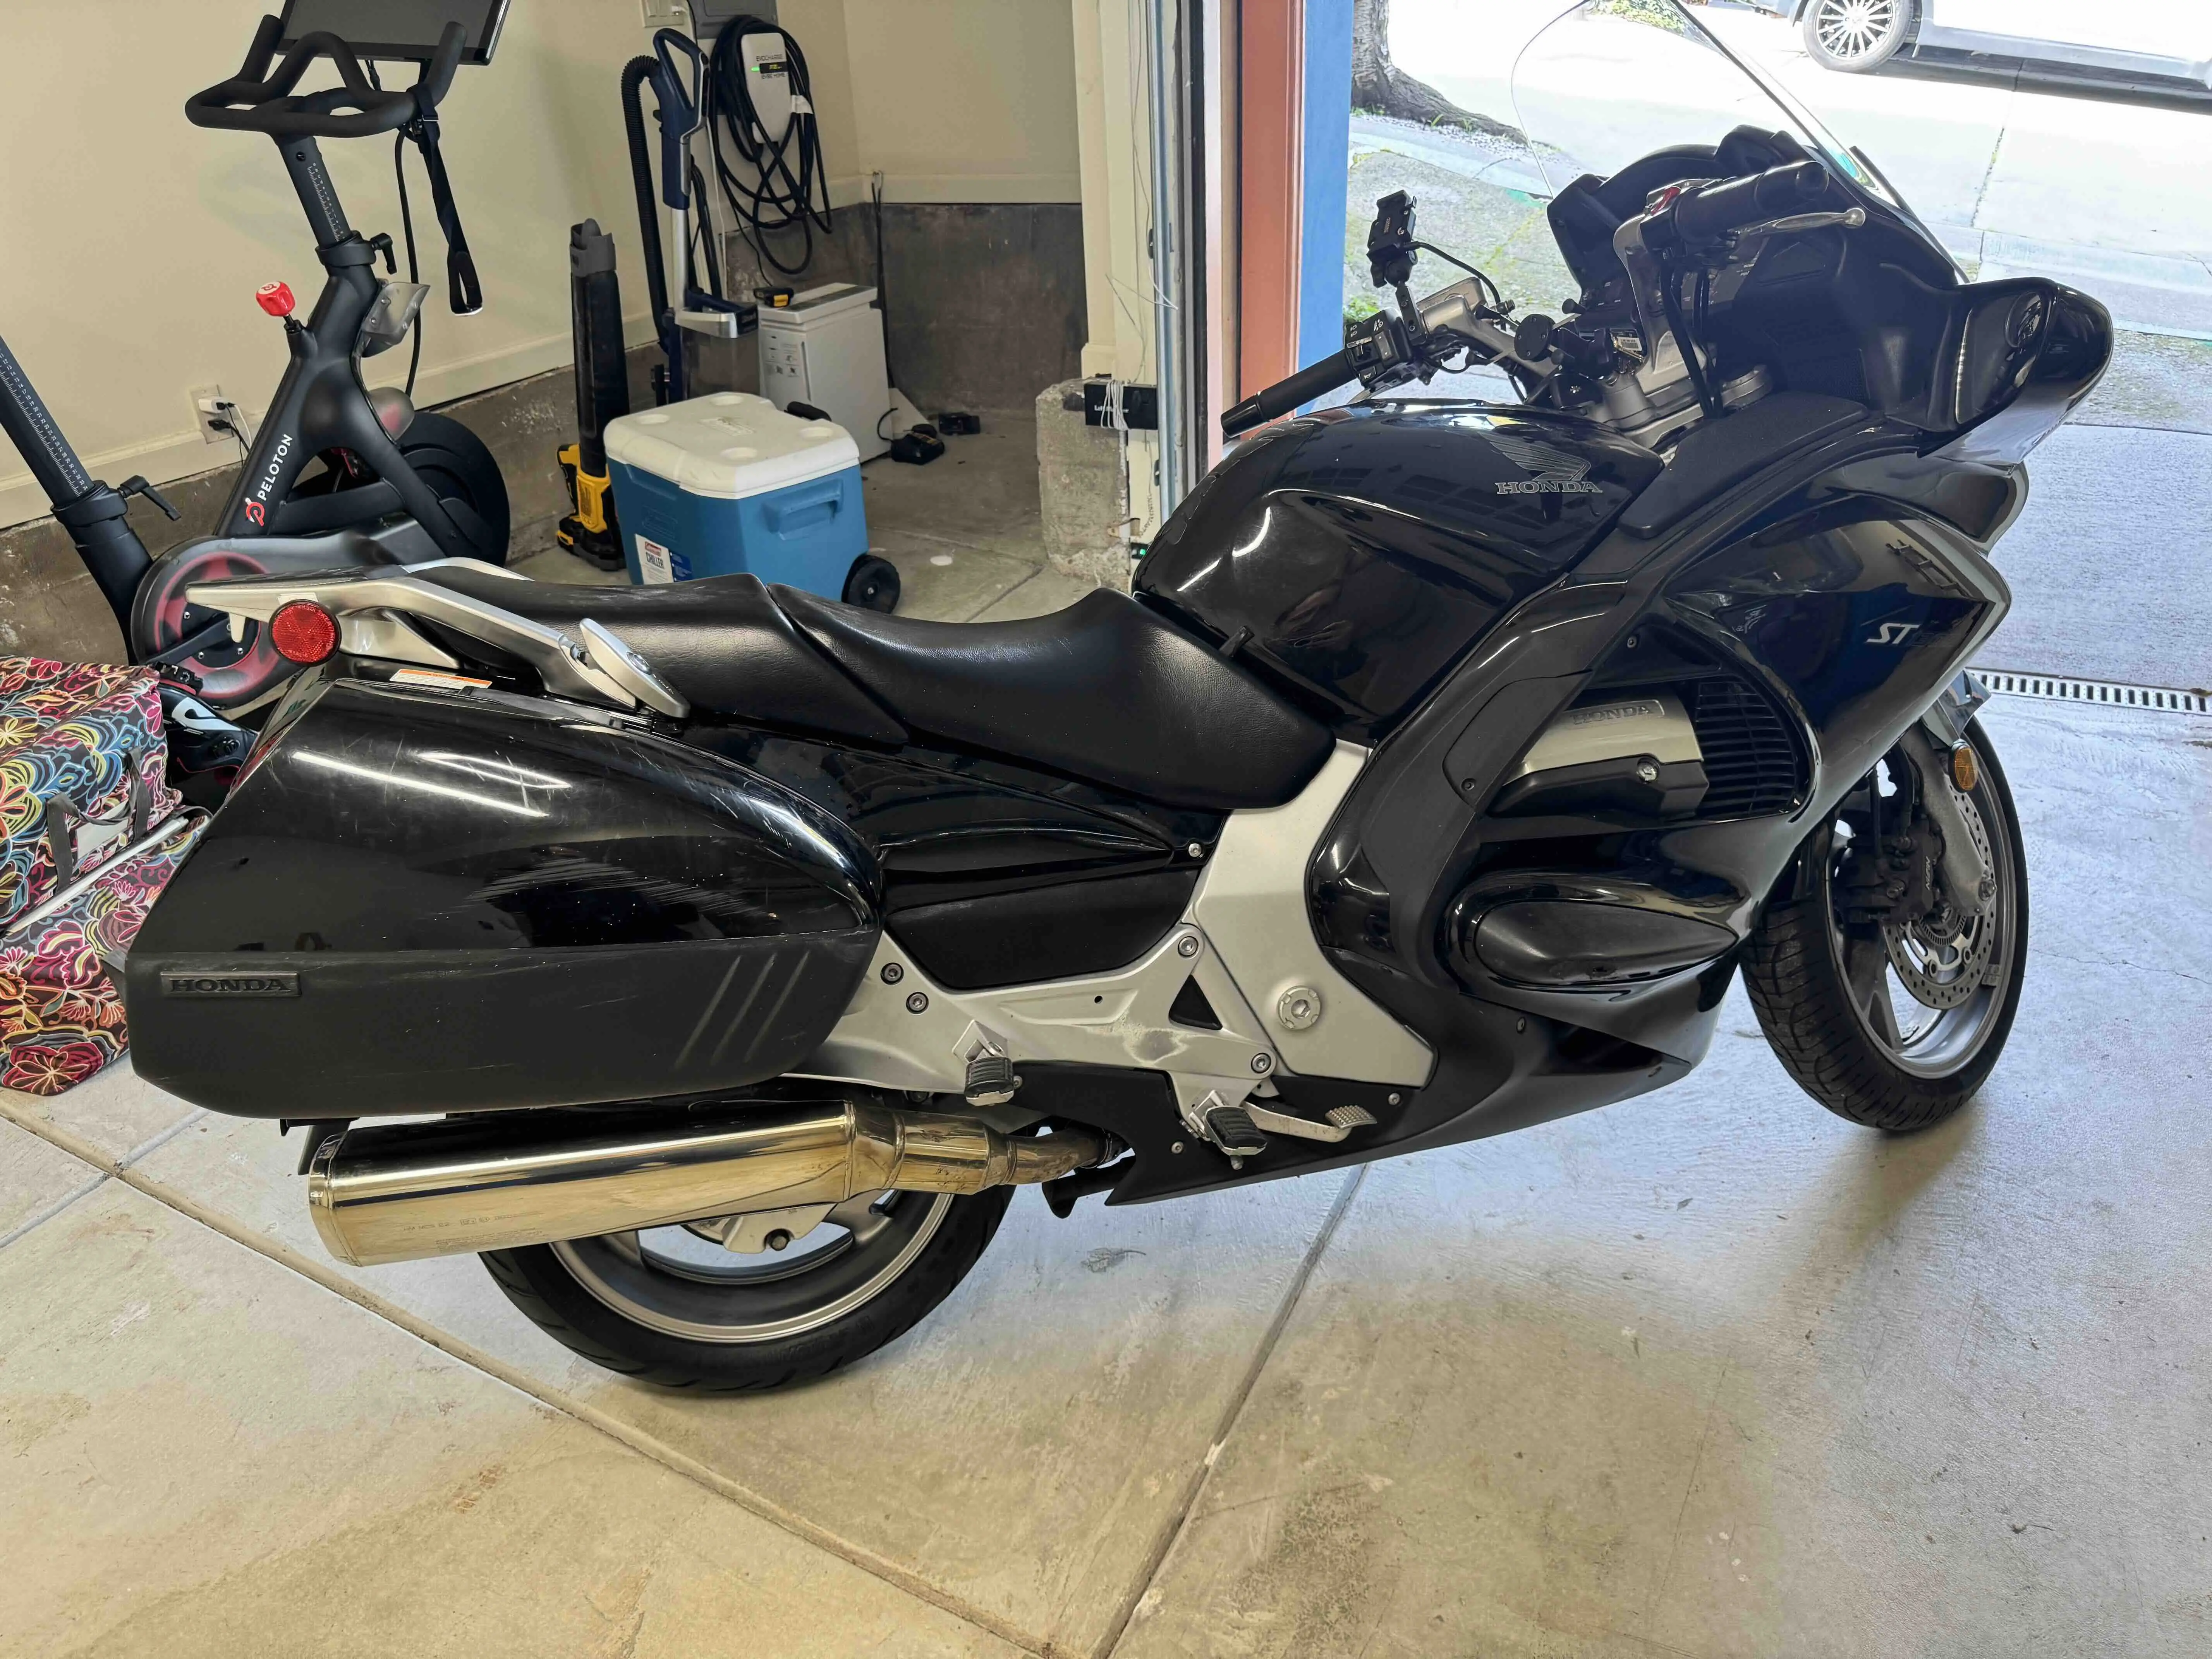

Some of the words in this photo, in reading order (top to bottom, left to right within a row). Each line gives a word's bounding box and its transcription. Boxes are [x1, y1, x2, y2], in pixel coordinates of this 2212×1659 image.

[257, 434, 292, 501] PELOTON
[1495, 481, 1603, 495] HONDA
[1866, 623, 1920, 644] ST
[1570, 706, 1654, 725] HONDA
[169, 979, 292, 993] HONDA
